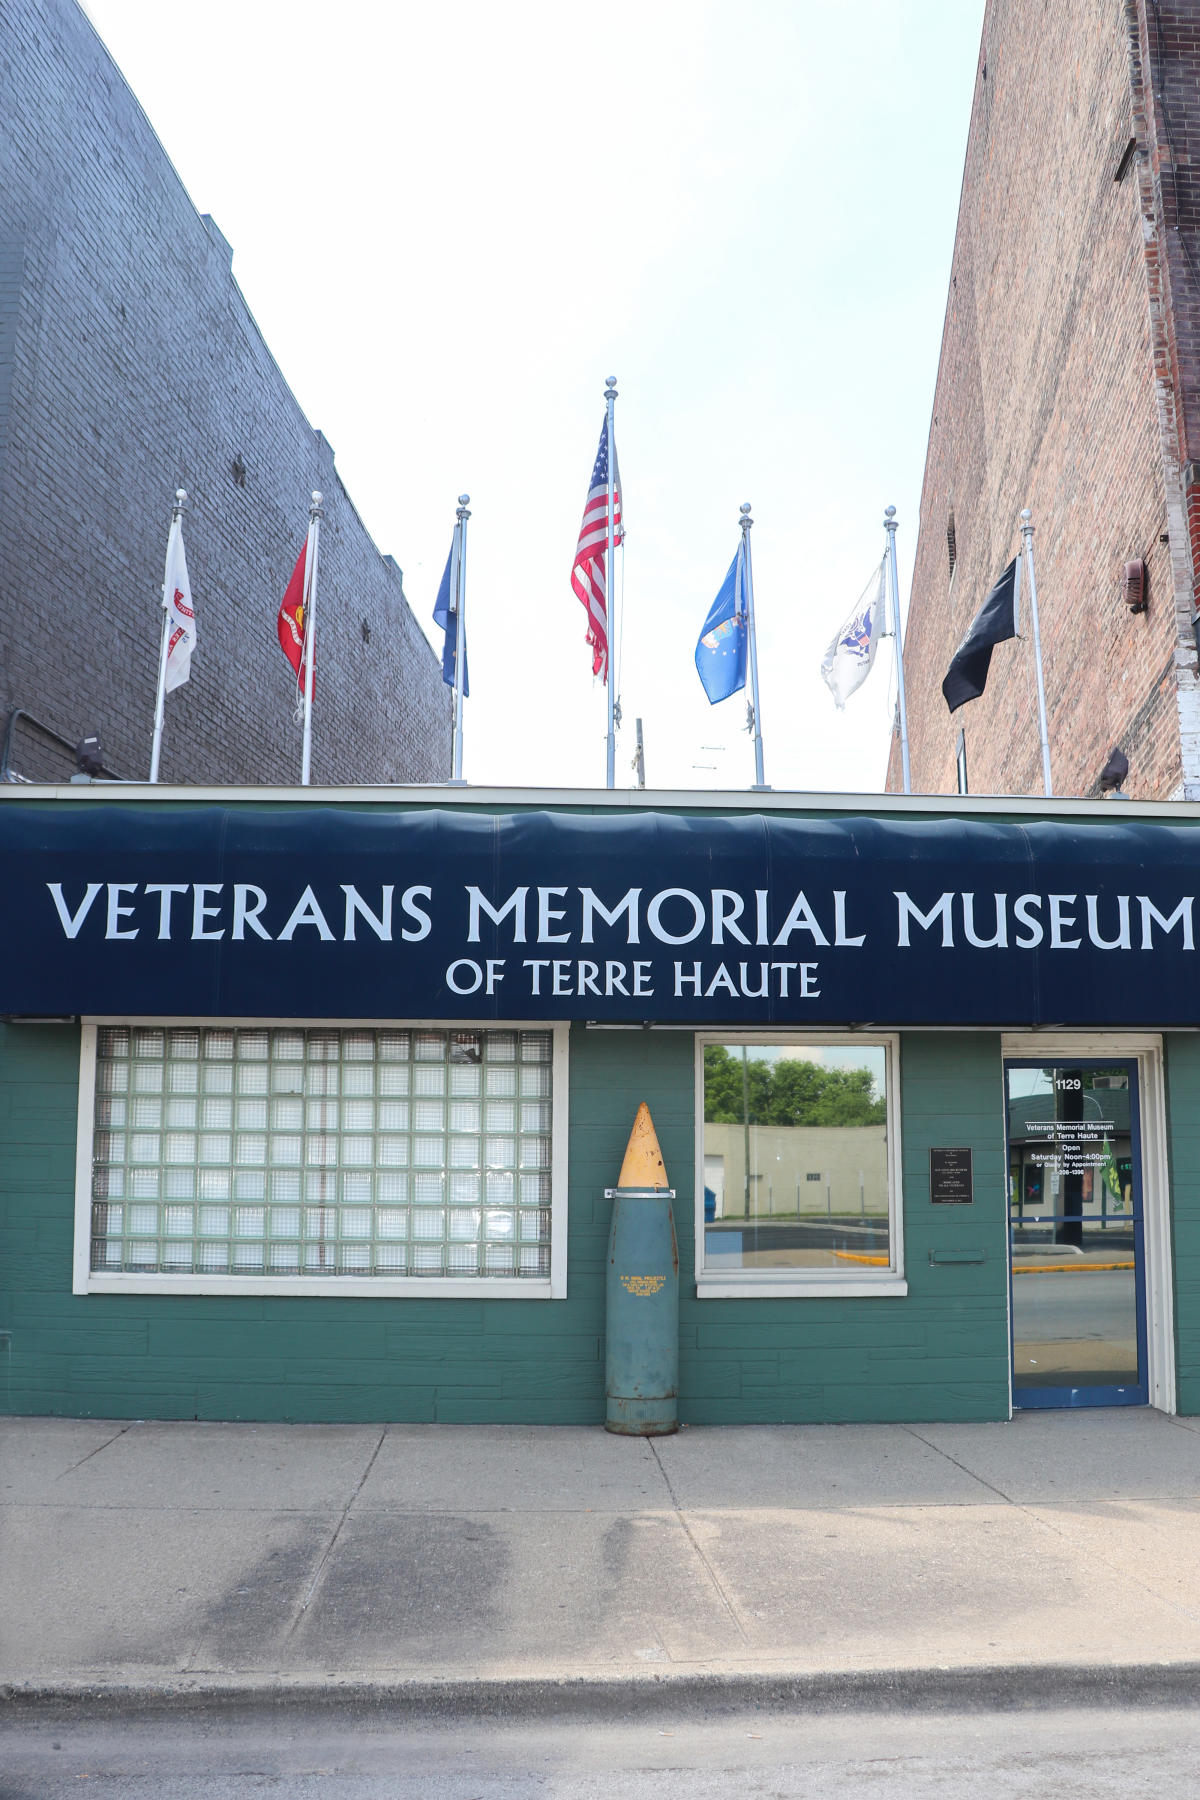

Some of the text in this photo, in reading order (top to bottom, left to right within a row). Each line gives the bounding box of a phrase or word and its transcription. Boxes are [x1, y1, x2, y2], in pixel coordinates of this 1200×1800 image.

[46, 883, 1195, 950] VETERANS MEMORIAL MUSEUM
[445, 958, 821, 998] OF TERRE HAUTE
[1055, 1079, 1081, 1090] 1129
[1056, 1123, 1085, 1131] Memorial
[1087, 1123, 1114, 1131] Museum
[1031, 1153, 1062, 1161] Saturday
